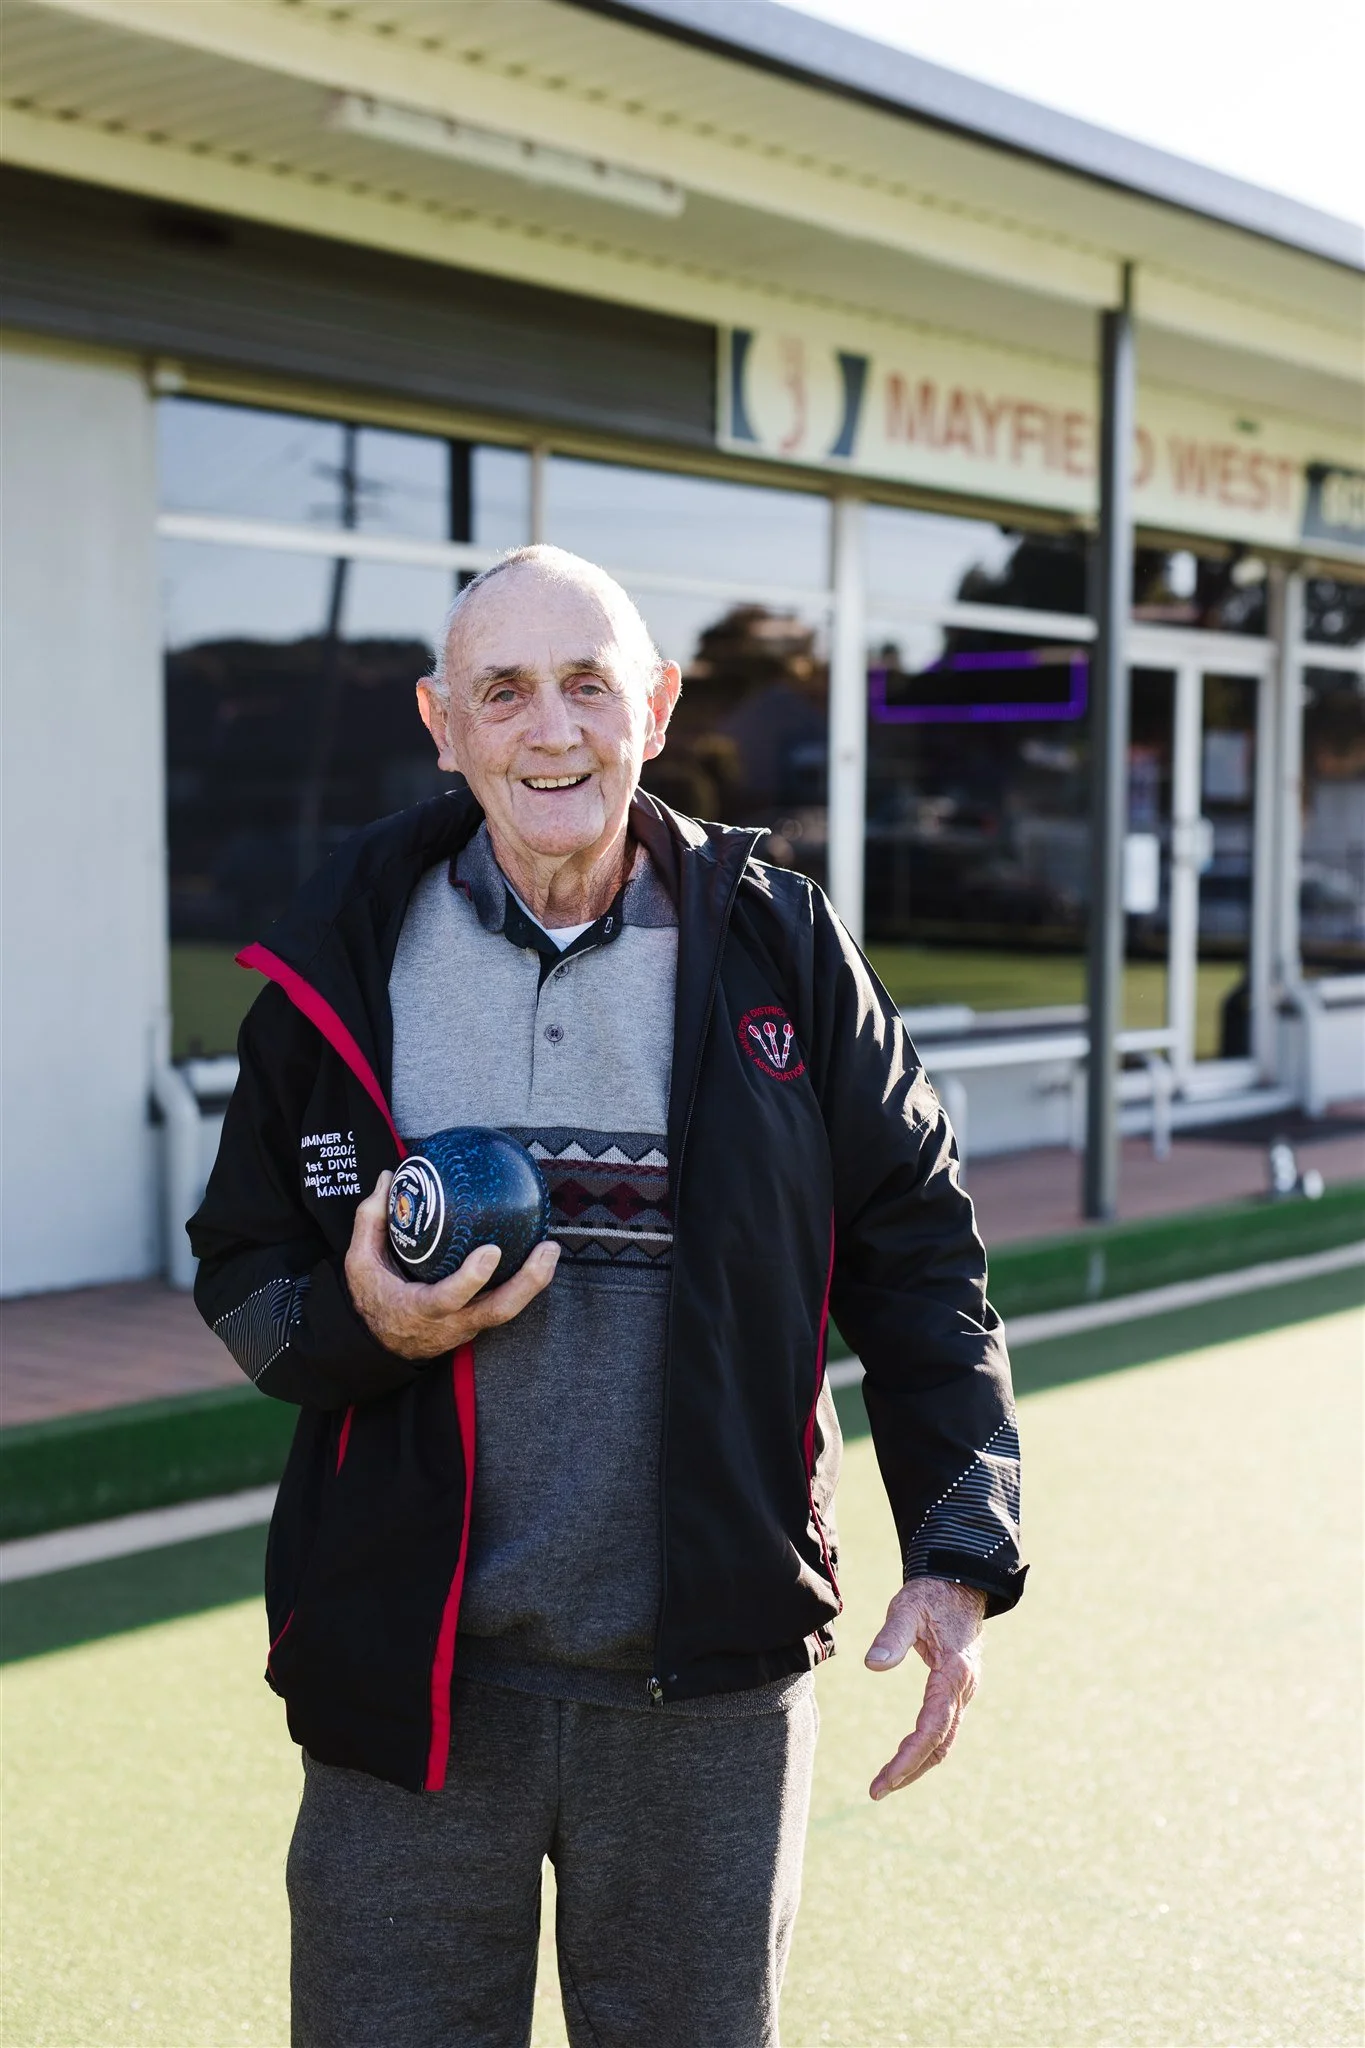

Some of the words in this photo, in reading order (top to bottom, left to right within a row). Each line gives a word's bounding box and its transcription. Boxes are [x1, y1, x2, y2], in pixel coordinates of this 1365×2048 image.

[885, 372, 1154, 490] MAYFIED
[1166, 433, 1295, 513] WEST
[753, 1057, 806, 1082] ASSOCIATION
[301, 1133, 341, 1149] UMMER
[306, 1161, 323, 1173] 1st
[337, 1171, 357, 1183] Pre
[317, 1183, 361, 1198] MAYWE
